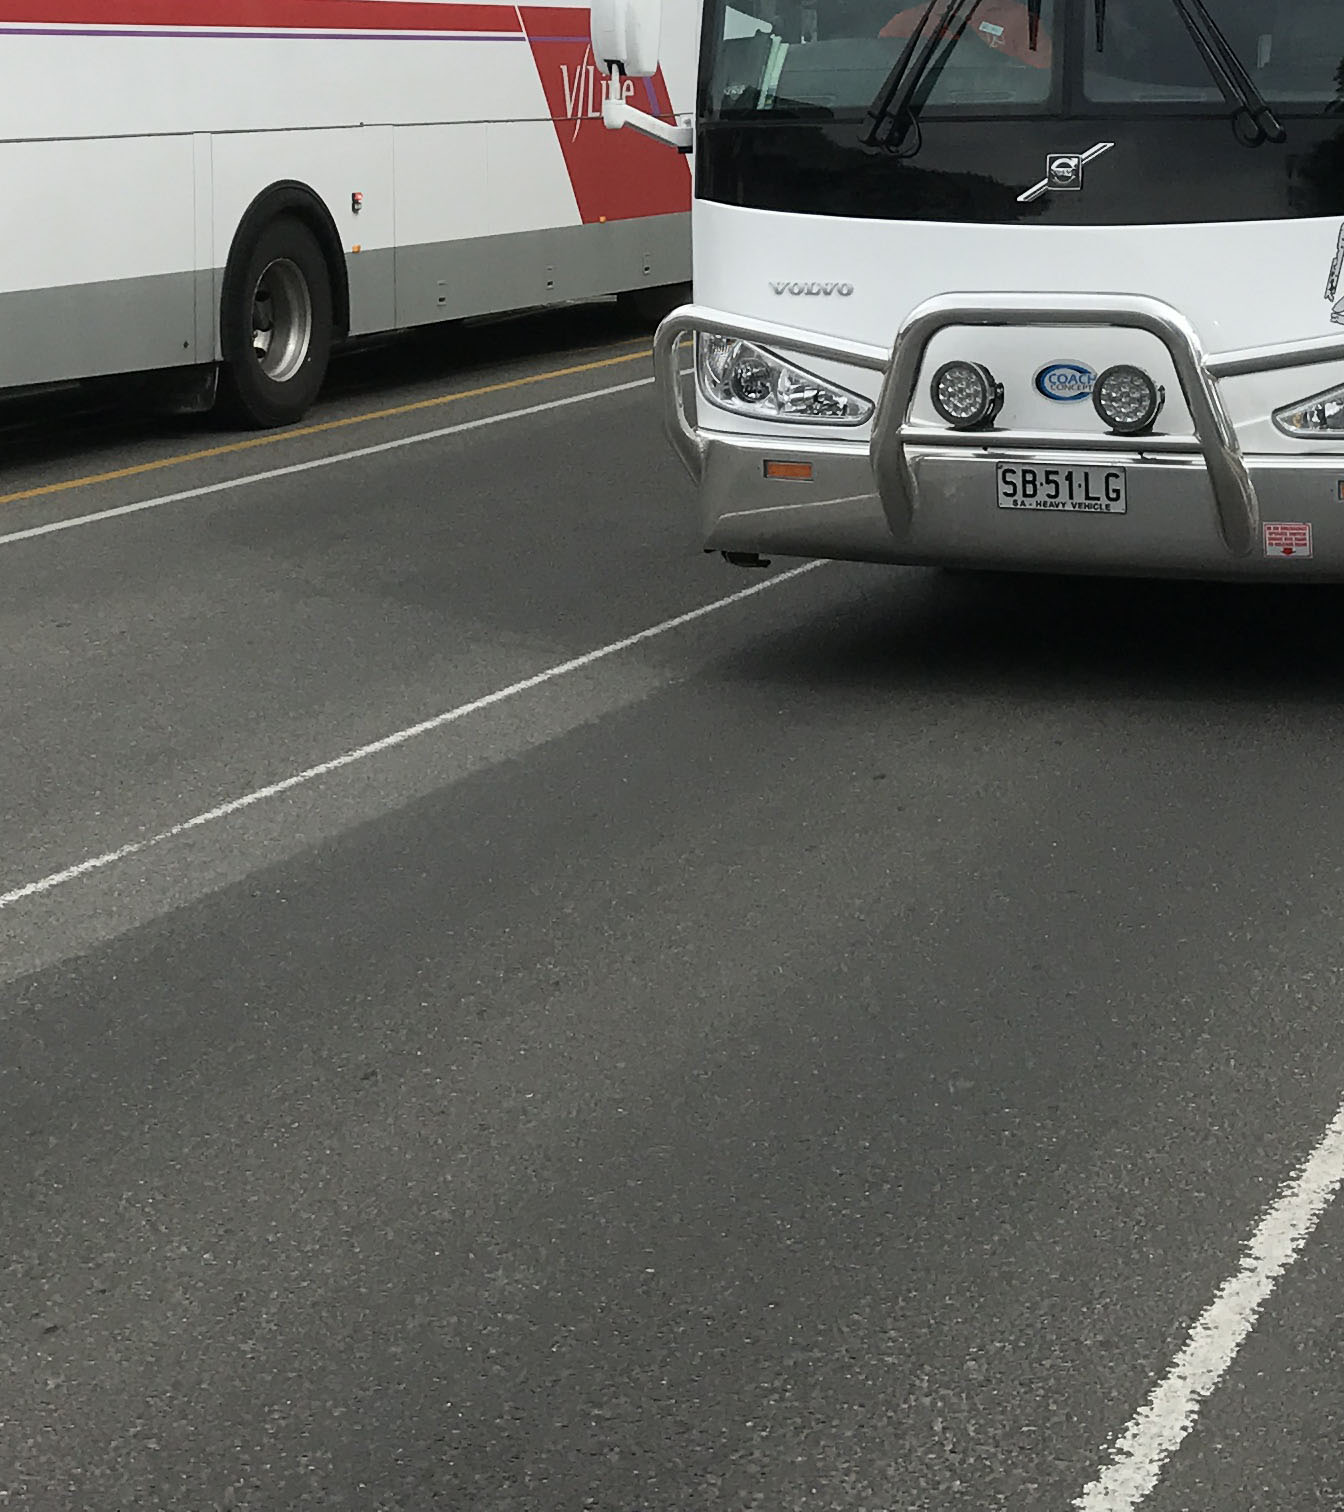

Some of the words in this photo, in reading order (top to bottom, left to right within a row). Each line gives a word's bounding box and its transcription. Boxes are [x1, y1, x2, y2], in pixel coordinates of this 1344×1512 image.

[768, 280, 854, 297] VOLVO
[1048, 373, 1097, 385] COACH
[1012, 499, 1027, 507] SA
[1035, 500, 1067, 509] HEAVY
[1071, 502, 1111, 511] VEHICLE
